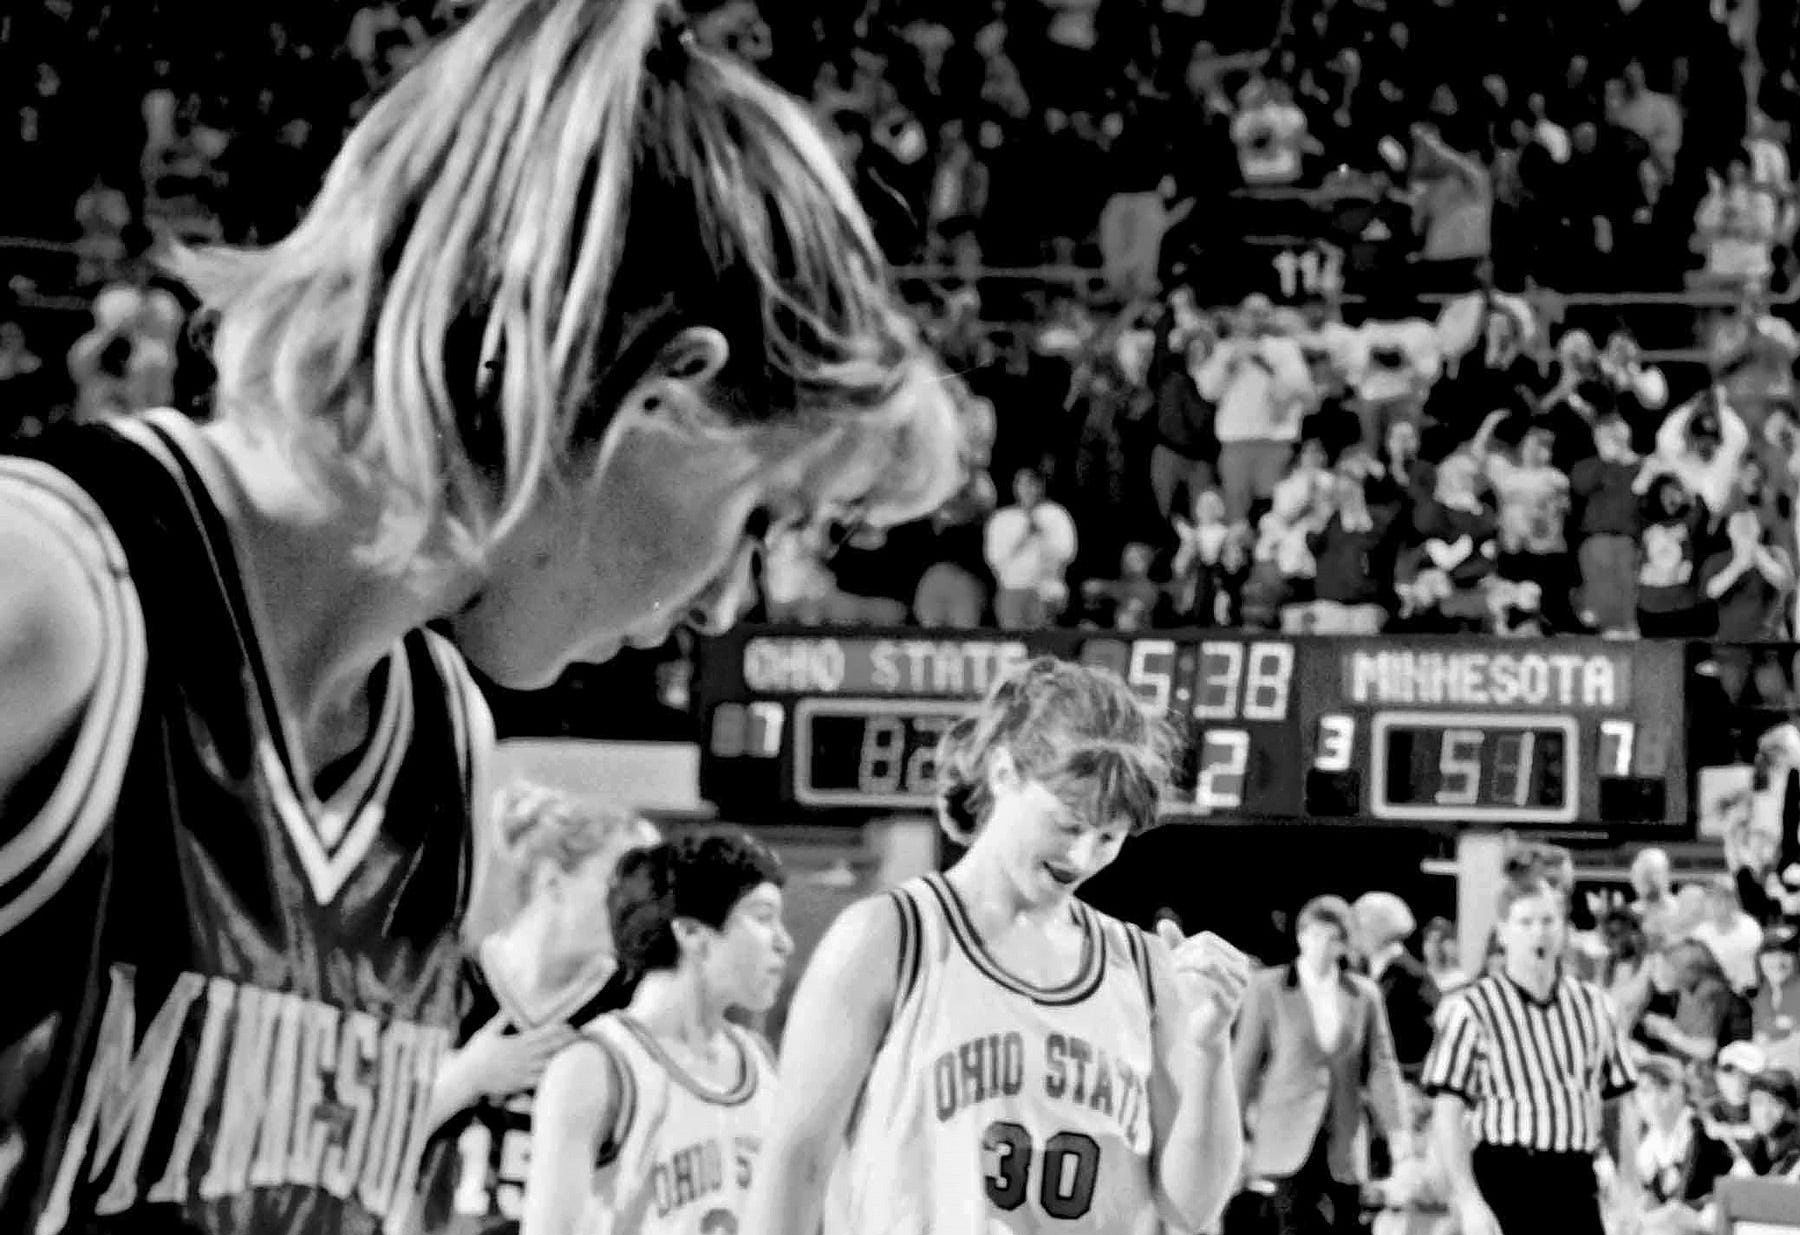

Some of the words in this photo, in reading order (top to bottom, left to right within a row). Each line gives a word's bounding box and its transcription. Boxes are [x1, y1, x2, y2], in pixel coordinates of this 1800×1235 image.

[743, 637, 845, 692] OHIO
[1352, 650, 1616, 706] MINNESOTA
[1196, 728, 1249, 808] 2
[1313, 714, 1355, 771] 3
[1433, 728, 1536, 808] 51
[1601, 720, 1636, 777] 7
[934, 1031, 1024, 1123] OHIO
[983, 1121, 1100, 1220] 30
